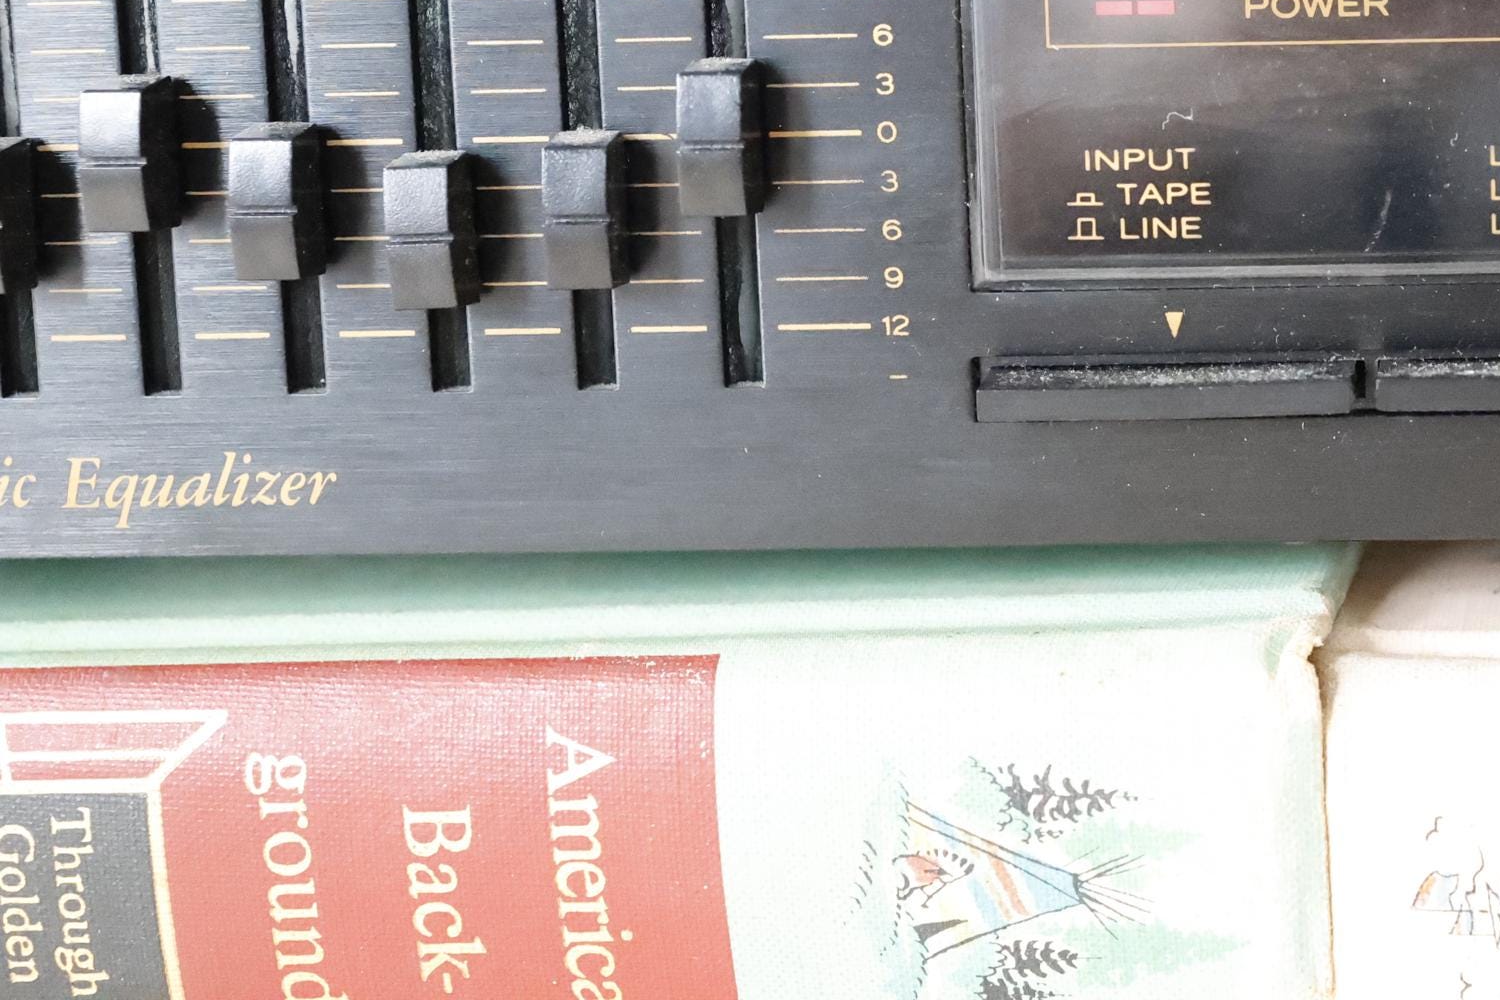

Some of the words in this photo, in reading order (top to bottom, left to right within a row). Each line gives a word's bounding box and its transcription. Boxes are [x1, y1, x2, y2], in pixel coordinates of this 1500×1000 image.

[873, 24, 893, 46] 6
[876, 72, 894, 95] 3
[877, 121, 897, 143] 0
[1085, 148, 1195, 171] INPUT
[881, 170, 899, 192] 3
[1117, 183, 1210, 205] TAPE
[882, 219, 902, 241] 6
[1120, 217, 1201, 239] LINE
[884, 267, 903, 288] 9
[882, 315, 909, 336] 12
[62, 452, 336, 529] Equalizer
[0, 823, 44, 984] Golden
[50, 806, 110, 997] Through
[402, 803, 487, 994] Back-
